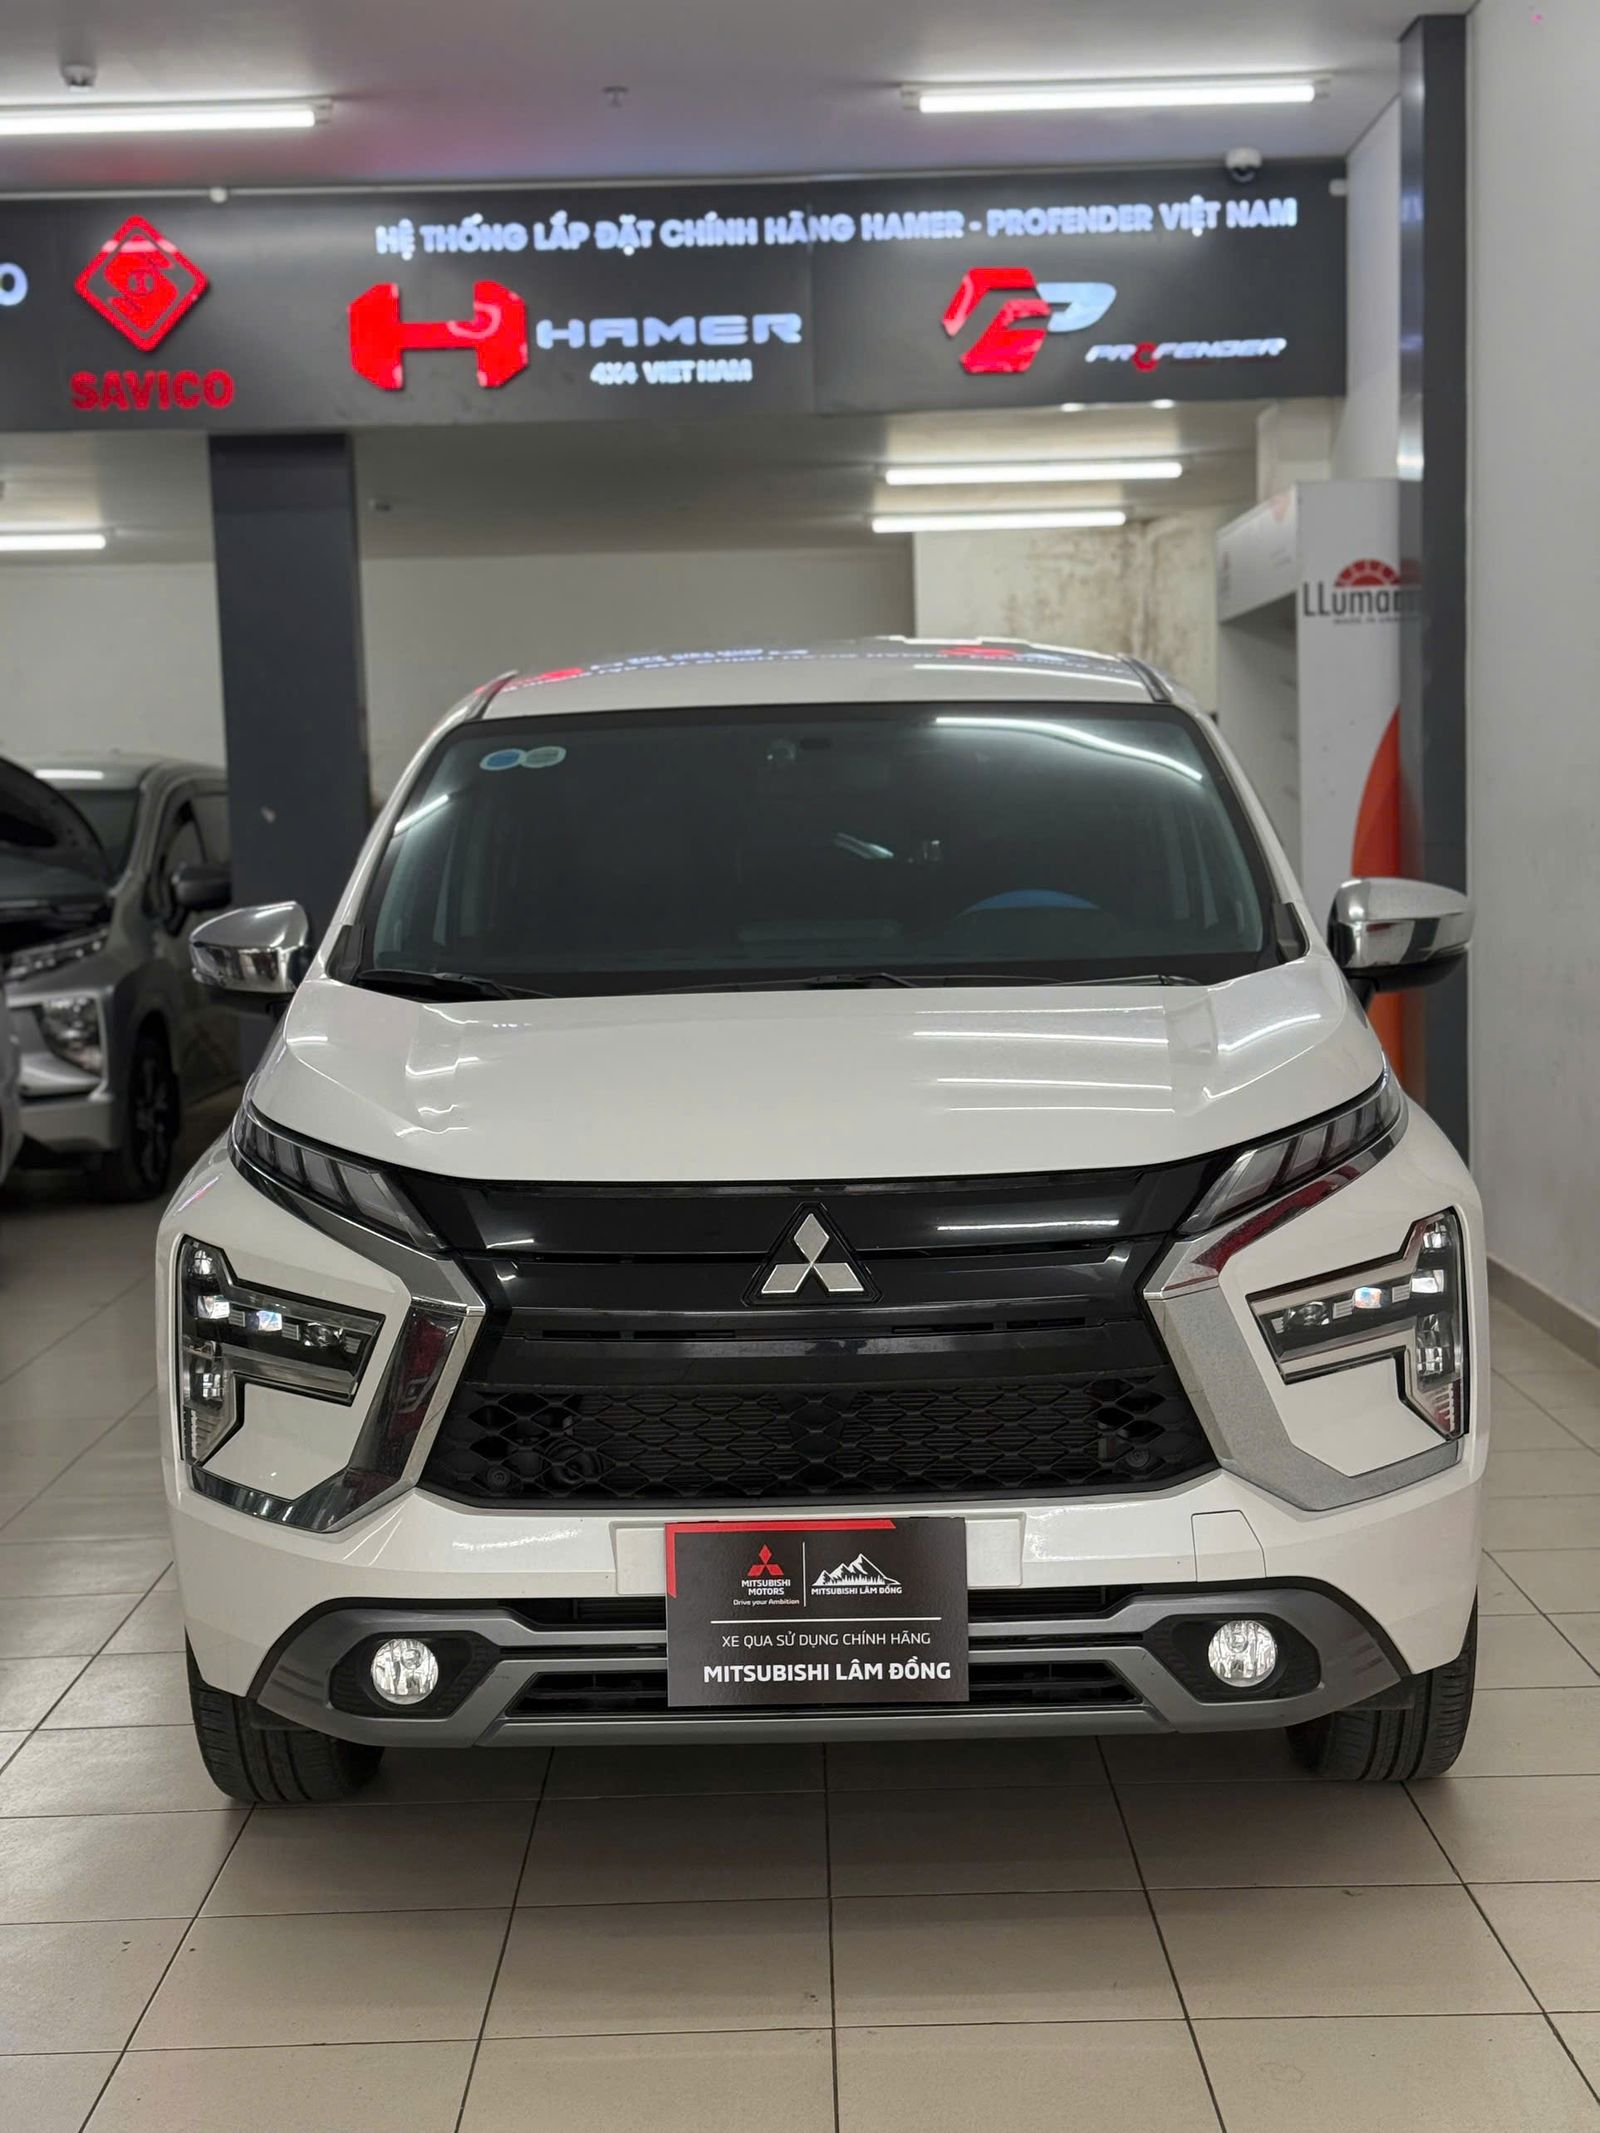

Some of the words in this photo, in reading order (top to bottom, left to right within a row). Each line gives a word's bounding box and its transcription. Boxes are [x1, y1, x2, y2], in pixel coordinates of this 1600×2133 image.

[375, 218, 416, 261] HỆ
[419, 212, 528, 252] THỐNG
[533, 209, 590, 250] LẮP
[594, 213, 656, 256] ĐẶT
[659, 210, 759, 247] CHÍNH
[861, 211, 965, 240] HAMER
[986, 204, 1154, 236] PROFENDER
[1157, 193, 1221, 237] VIỆT
[1225, 197, 1298, 228] NAM
[536, 313, 802, 349] HAMER
[1085, 338, 1287, 373] PROFENDER
[695, 358, 753, 383] NAM
[69, 369, 236, 412] SAVICO
[741, 1578, 791, 1587] MITSUBISHI
[748, 1587, 785, 1596] MOTORS
[811, 1586, 858, 1595] MITSUBISHI
[722, 1635, 740, 1648] XE
[743, 1633, 773, 1649] QUA
[776, 1630, 796, 1647] SỬ
[799, 1633, 839, 1649] DỤNG
[842, 1630, 886, 1646] CHÍNH
[890, 1630, 932, 1645] HÃNG
[703, 1663, 829, 1684] MITSUBISHI
[835, 1658, 883, 1682] LÂM
[889, 1655, 951, 1681] ĐỒNG
